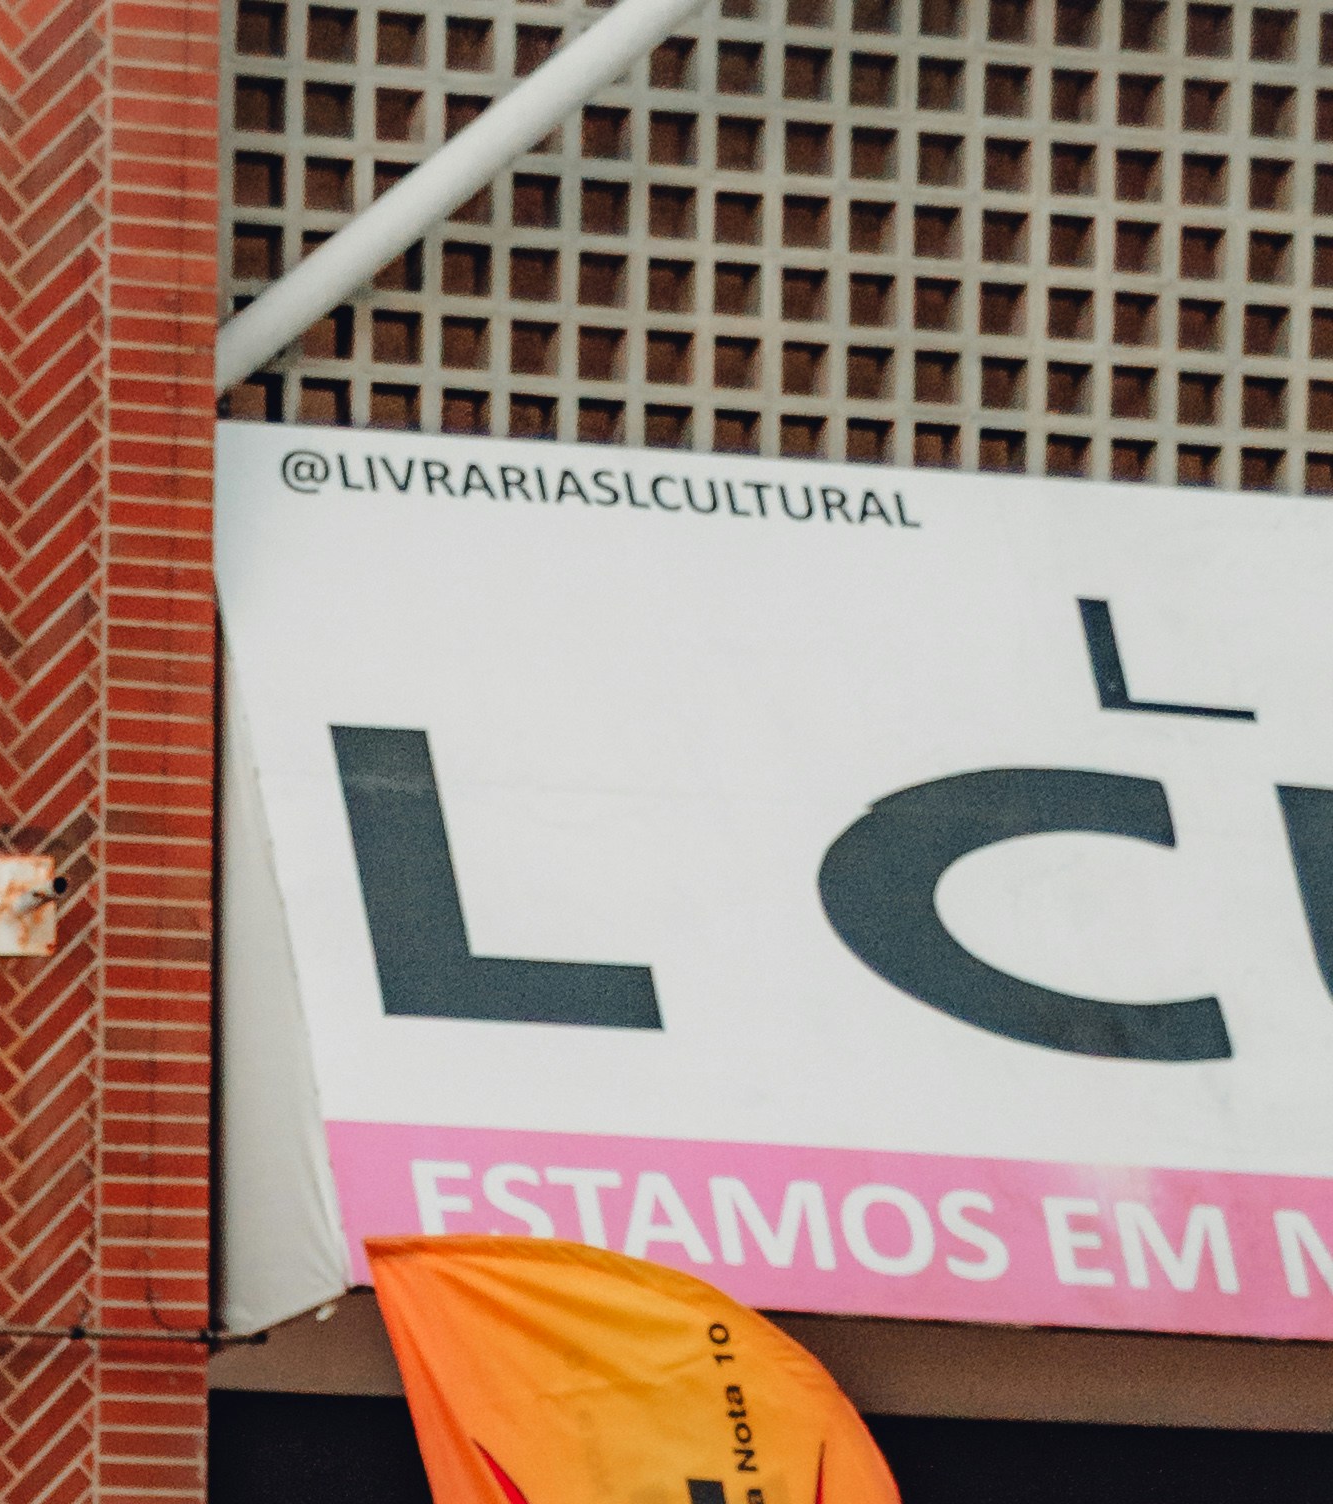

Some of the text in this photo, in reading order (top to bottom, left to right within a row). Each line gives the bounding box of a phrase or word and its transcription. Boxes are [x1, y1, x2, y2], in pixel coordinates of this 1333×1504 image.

[280, 448, 922, 529] @LIVRARIASLCULTURAL
[409, 1158, 1010, 1282] ESTAMOS
[1041, 1194, 1241, 1296] EM
[707, 1321, 735, 1366] 10
[725, 1383, 759, 1474] Nota
